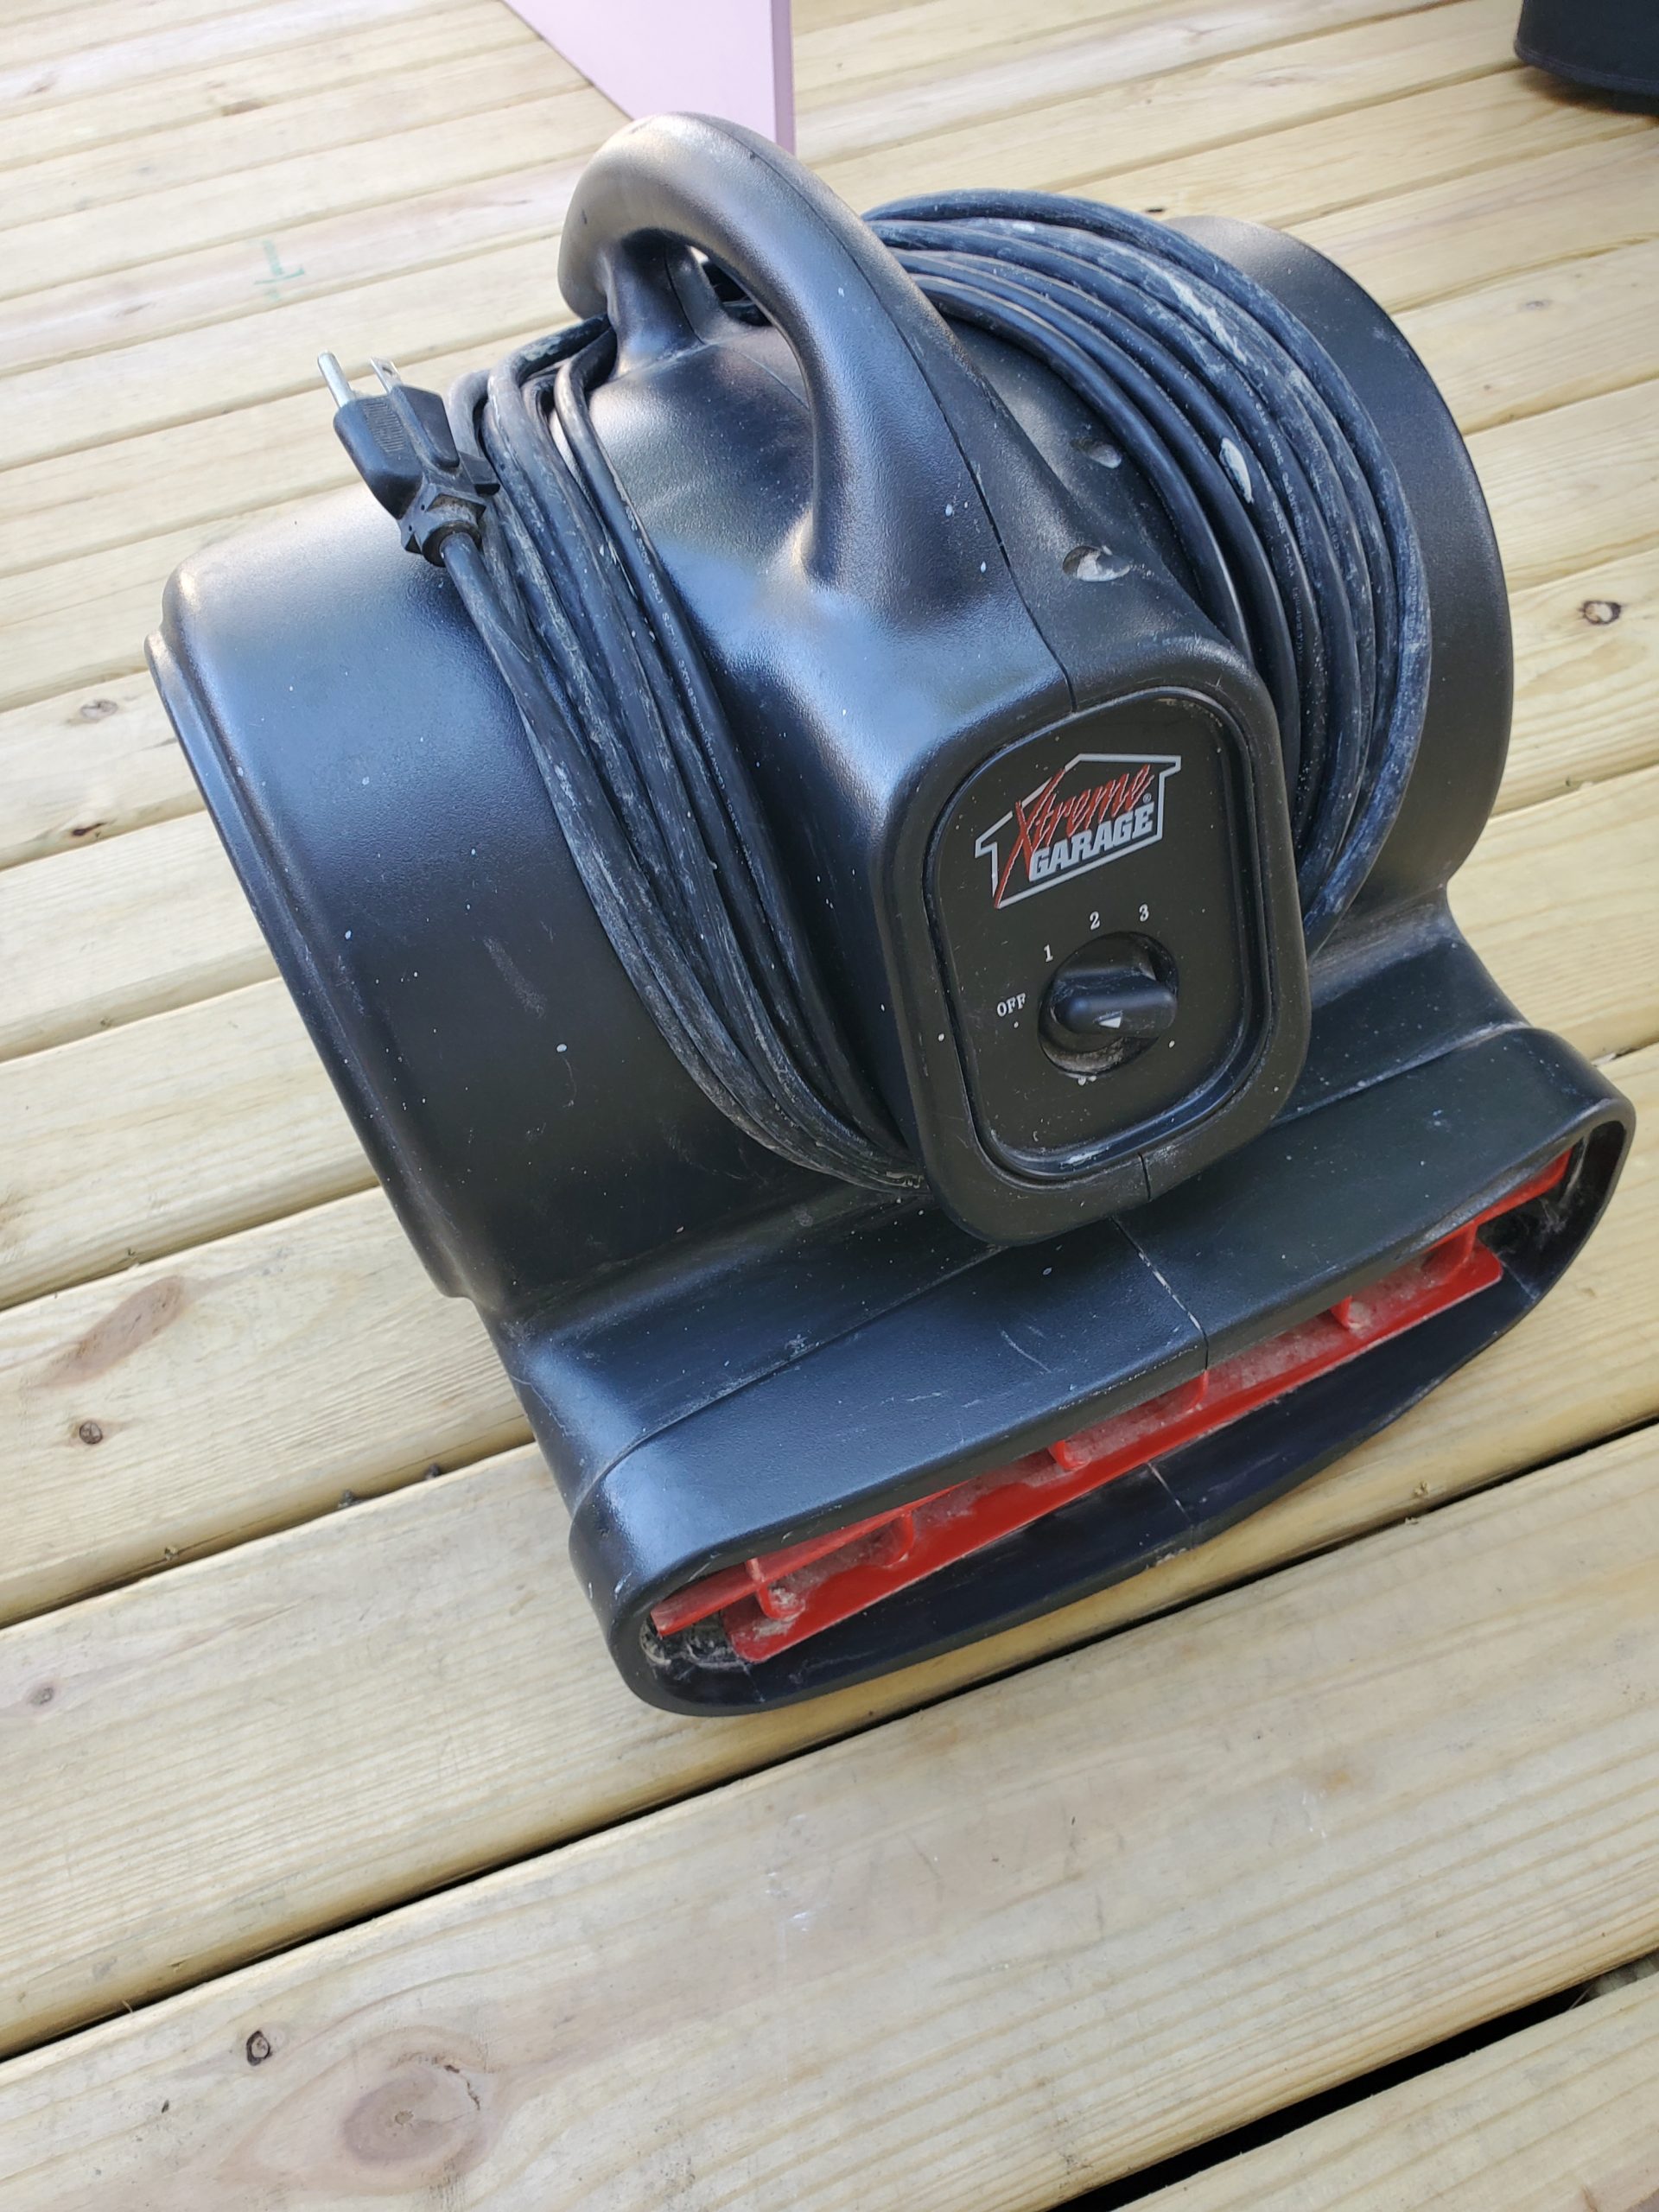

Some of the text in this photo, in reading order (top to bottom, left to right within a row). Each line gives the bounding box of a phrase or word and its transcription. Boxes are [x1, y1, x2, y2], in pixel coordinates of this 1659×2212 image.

[995, 764, 1155, 908] Xtreme
[1028, 801, 1155, 882] GARAGE
[1089, 911, 1101, 931] 2
[1138, 904, 1149, 922] 3
[1043, 944, 1053, 963] 1
[996, 993, 1027, 1018] OFF
